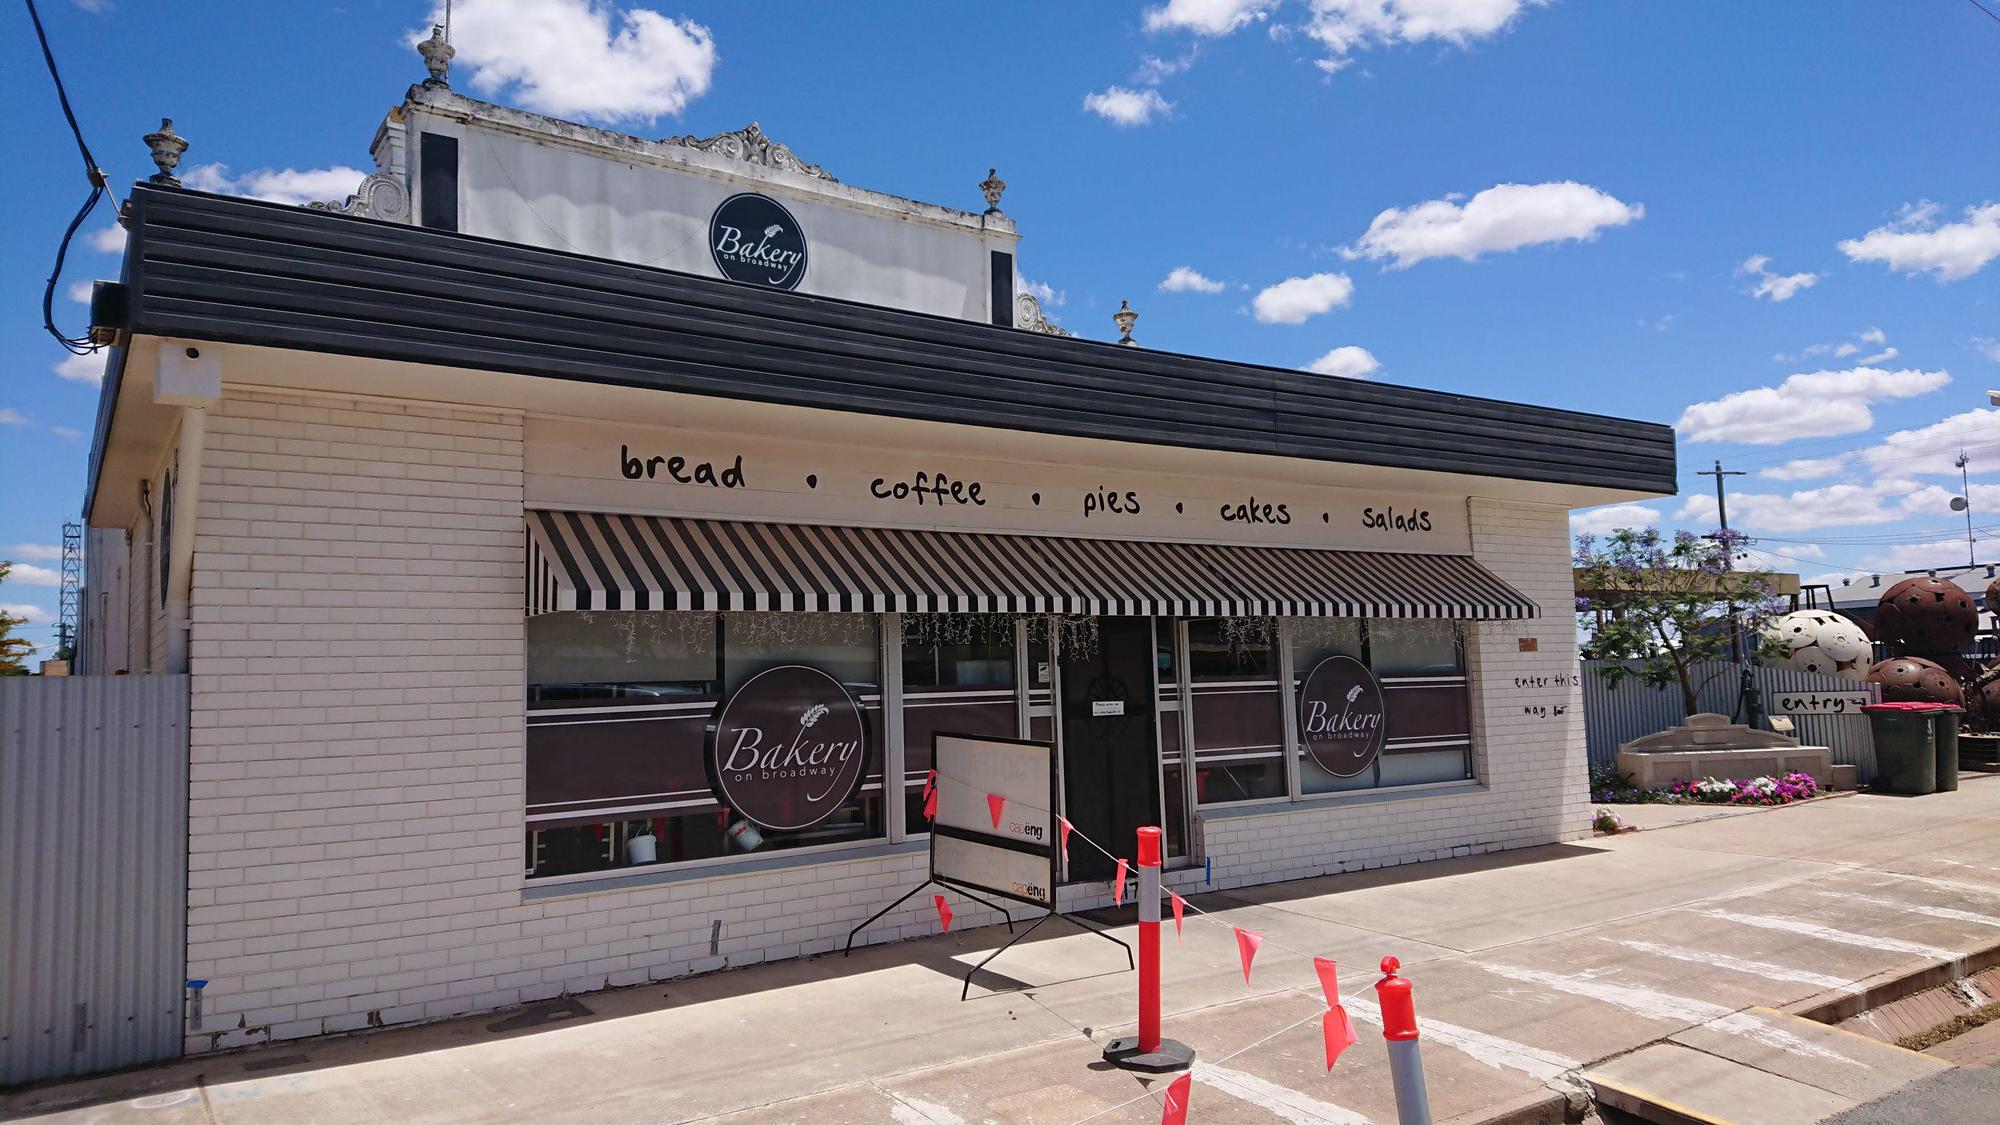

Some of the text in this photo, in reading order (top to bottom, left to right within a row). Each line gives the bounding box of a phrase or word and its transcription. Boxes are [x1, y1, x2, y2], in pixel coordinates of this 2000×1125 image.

[716, 225, 802, 284] Bakery
[723, 253, 788, 272] on broadway
[621, 444, 745, 489] bread
[870, 471, 986, 507] coffee
[1084, 485, 1141, 517] pies
[1220, 496, 1292, 526] cakes
[1514, 672, 1579, 689] enter this
[1524, 705, 1547, 719] way
[1781, 694, 1845, 713] entry
[1306, 698, 1381, 757] Bakery
[1312, 731, 1369, 741] on broadway
[723, 722, 858, 801] Bakery
[734, 766, 836, 782] on broadway
